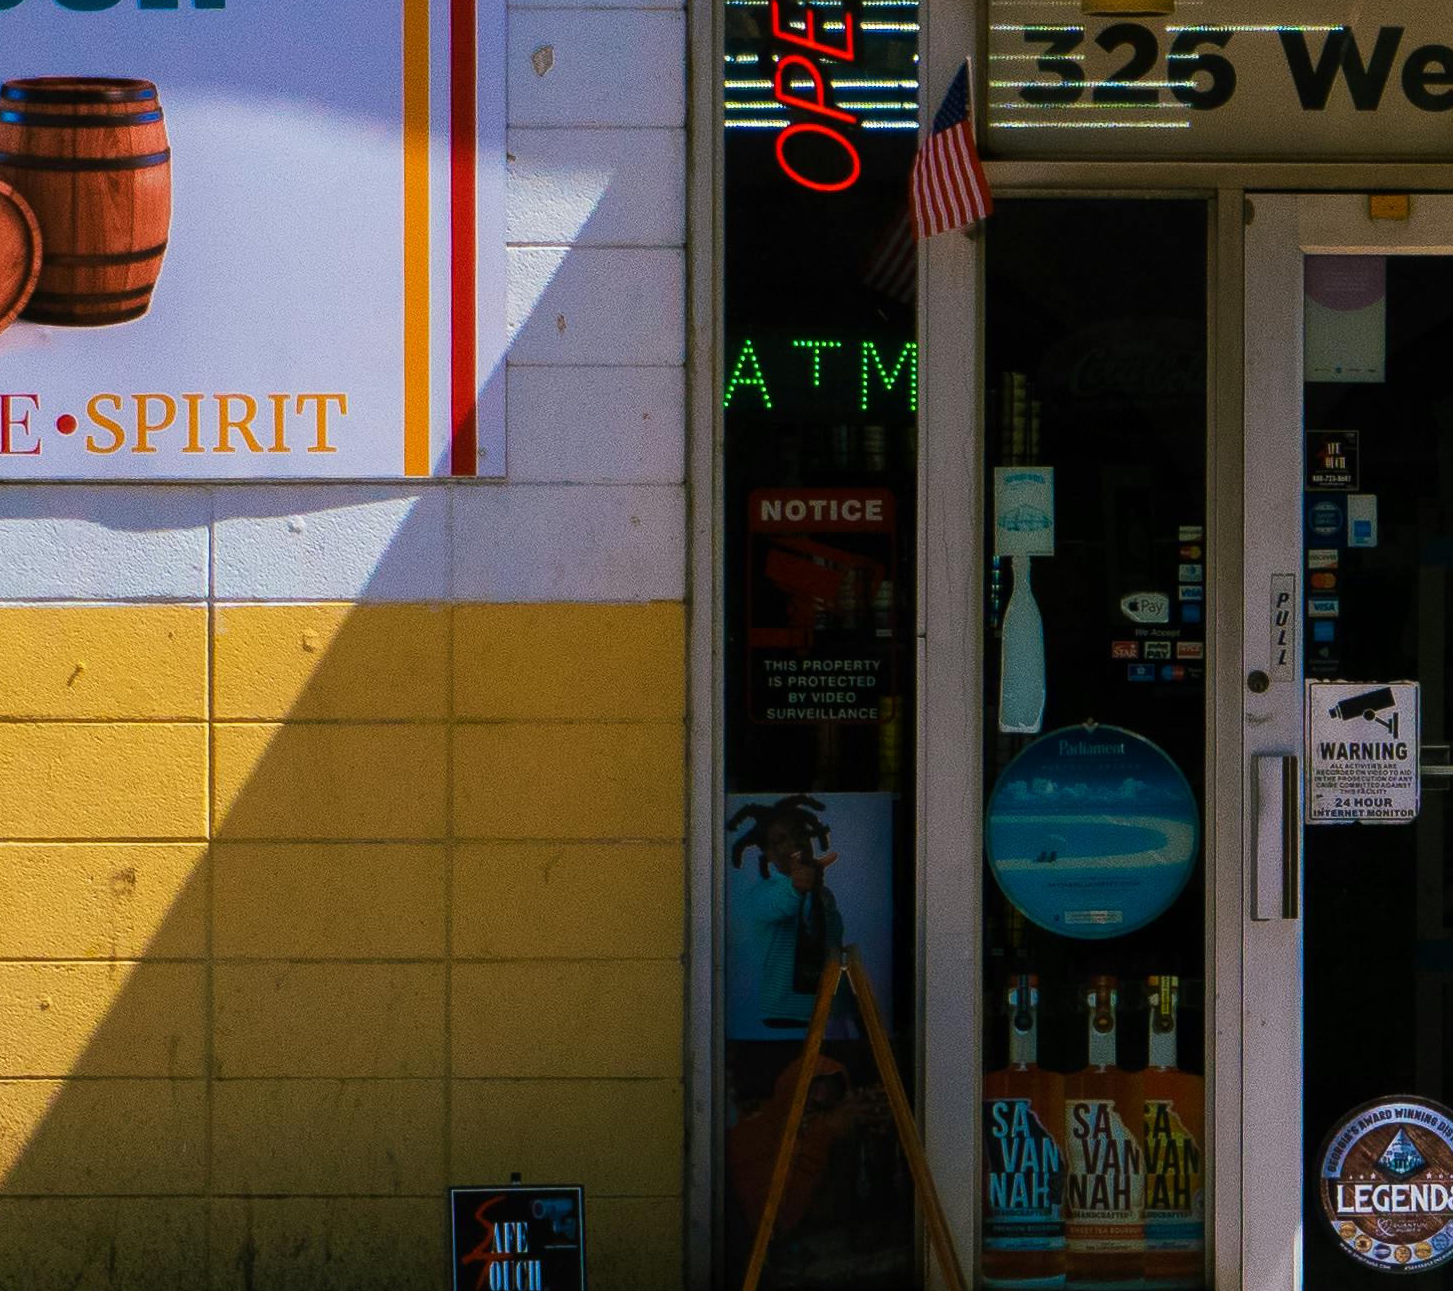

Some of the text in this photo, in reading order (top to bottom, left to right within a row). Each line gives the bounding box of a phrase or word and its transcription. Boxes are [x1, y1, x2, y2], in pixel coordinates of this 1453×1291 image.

[1019, 22, 1237, 111] 326
[723, 339, 918, 410] ATM
[84, 392, 349, 457] SPIRIT
[760, 499, 884, 522] NOTICE
[1141, 600, 1165, 616] Pay
[1276, 591, 1290, 667] PULL
[763, 659, 881, 673] THIS PROPERTY
[768, 675, 876, 689] IS PROTECTED
[788, 691, 857, 705] BY VIDEO
[766, 707, 879, 721] SURVEILLANCE
[1058, 740, 1126, 757] Parliament
[1320, 742, 1408, 761] WARNING
[1313, 809, 1414, 817] INTERNET MONITOR
[1335, 798, 1392, 808] 24 HOUR
[991, 1102, 1031, 1139] SA
[1073, 1103, 1113, 1140] SA
[1358, 1110, 1392, 1132] AWARD
[1394, 1108, 1437, 1127] WINNING
[1000, 1137, 1062, 1174] VAN
[1082, 1138, 1140, 1175] VAN
[1145, 1138, 1199, 1175] VAN
[990, 1172, 1051, 1209] NAH
[1068, 1173, 1131, 1209] NAH
